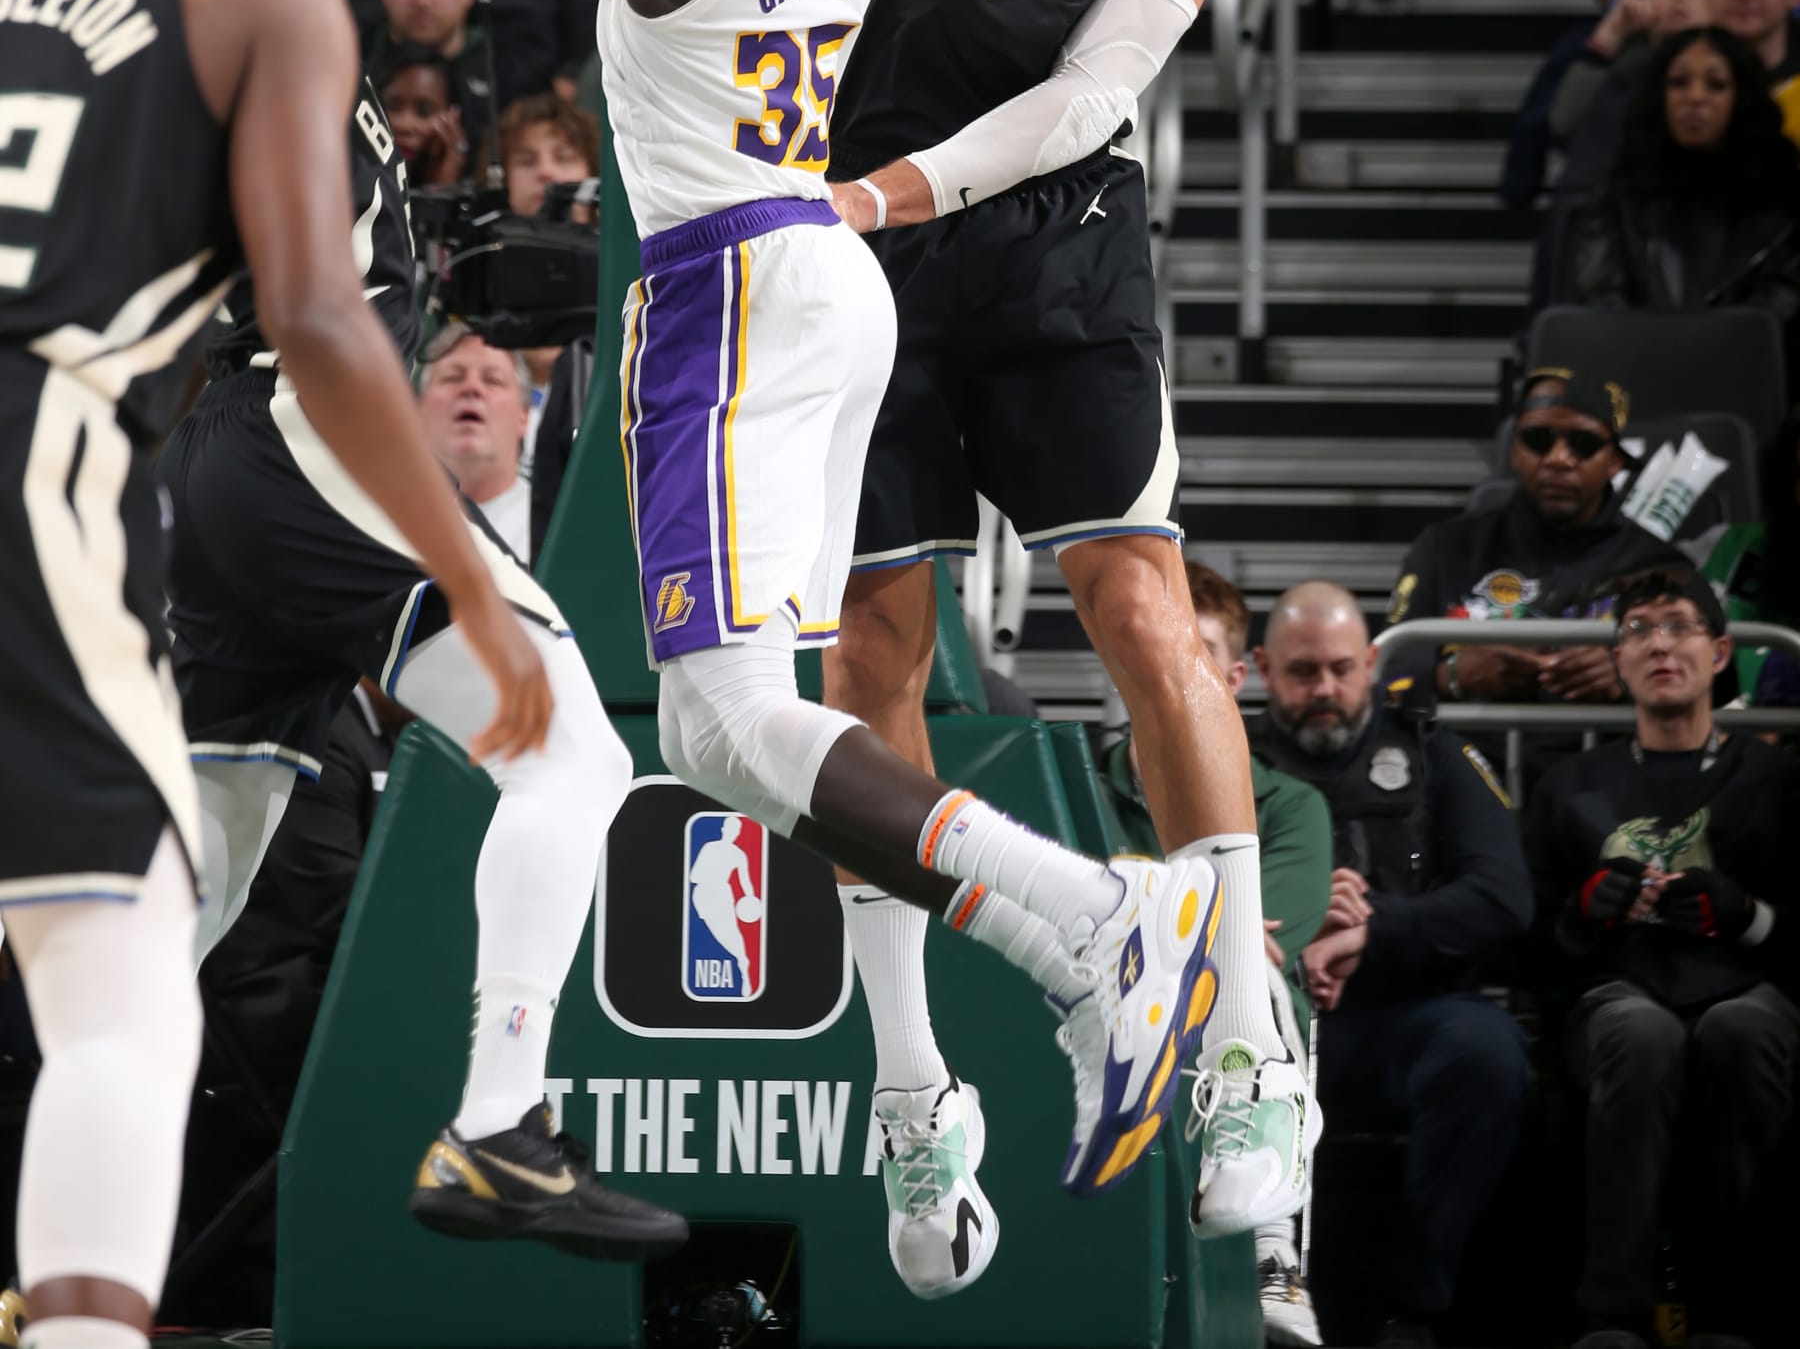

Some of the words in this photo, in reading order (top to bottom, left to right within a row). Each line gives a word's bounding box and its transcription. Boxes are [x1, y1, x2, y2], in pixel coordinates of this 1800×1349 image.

[733, 20, 862, 173] 35
[695, 959, 734, 988] NBA
[586, 1078, 701, 1174] THE
[716, 1080, 852, 1176] NEW
